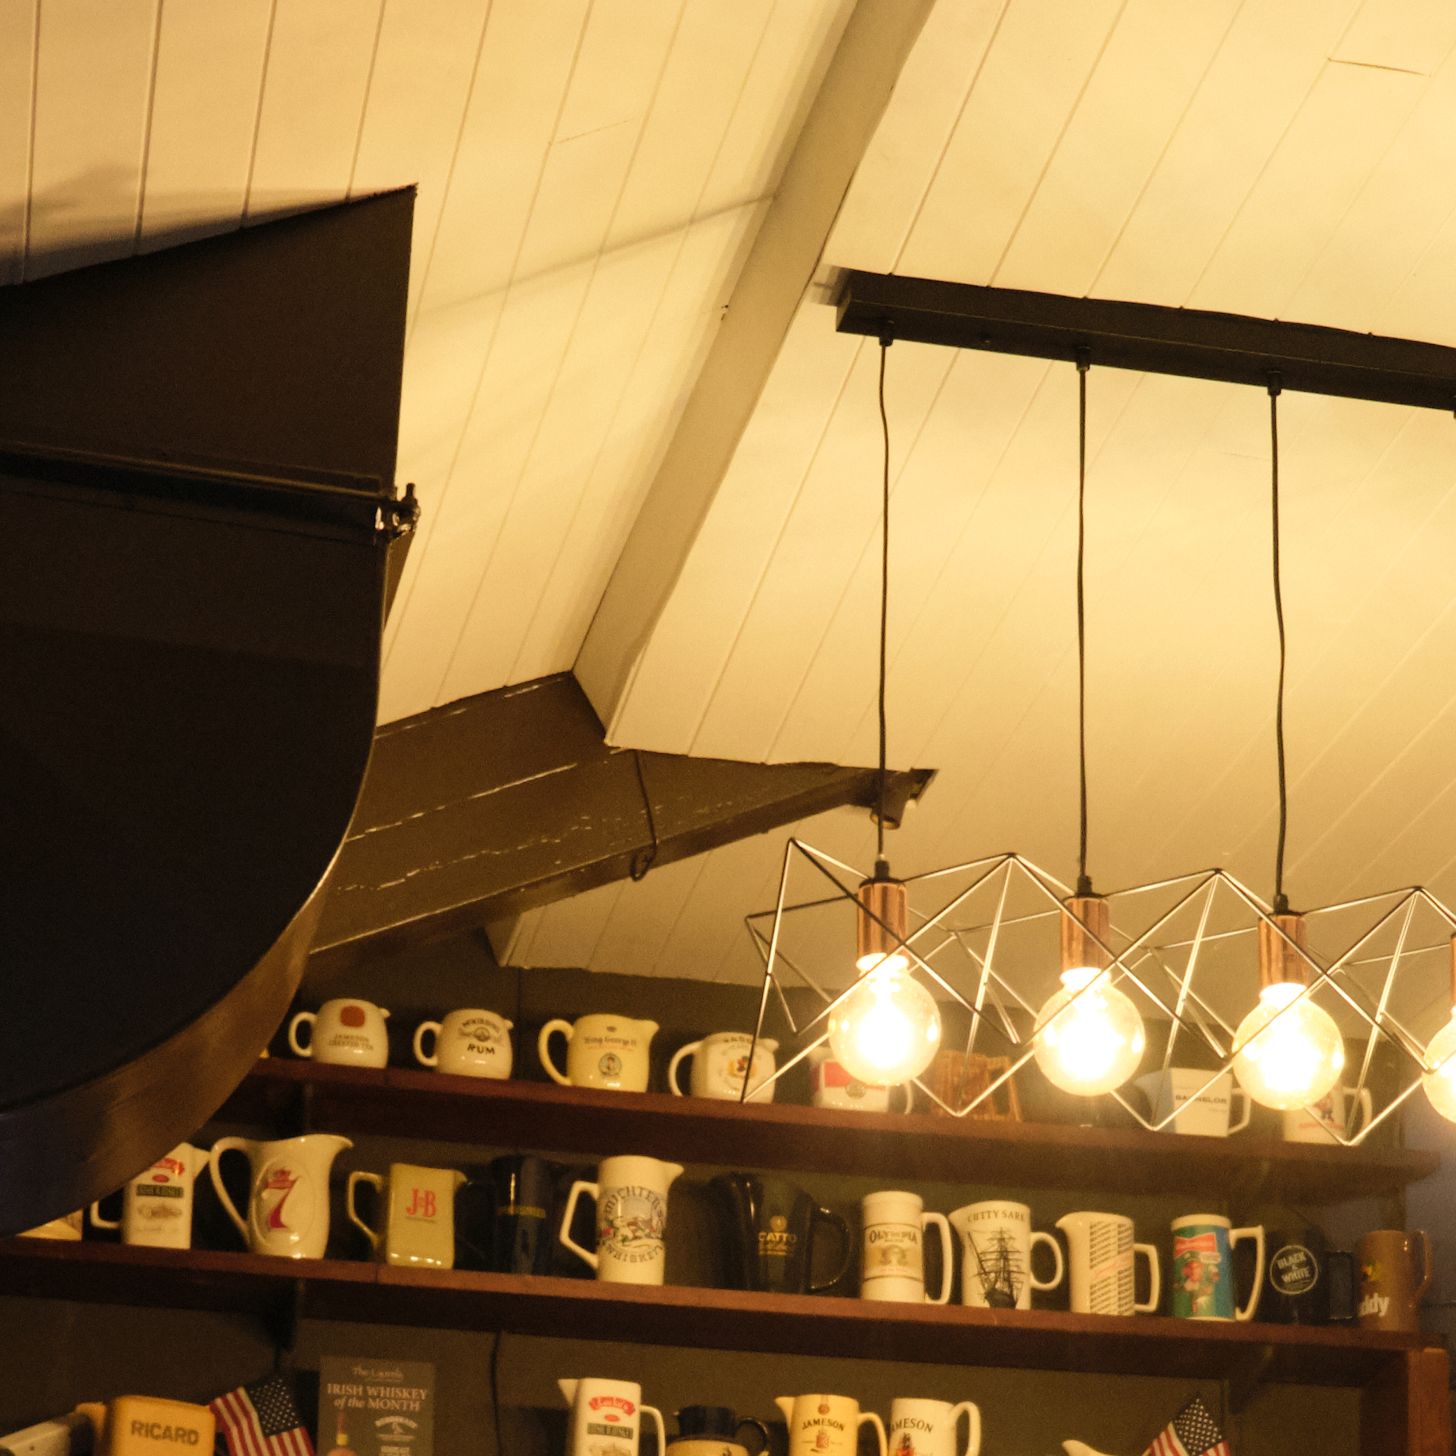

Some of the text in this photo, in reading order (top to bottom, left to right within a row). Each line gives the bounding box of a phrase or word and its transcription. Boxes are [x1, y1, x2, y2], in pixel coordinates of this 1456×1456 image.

[467, 1043, 495, 1055] RUM
[1276, 1251, 1307, 1271] BLACK
[1280, 1268, 1311, 1284] WHITE
[327, 1383, 428, 1400] IRISH WHISKEY
[334, 1397, 421, 1412] of the MONTH
[131, 1420, 199, 1446] RICARD
[802, 1418, 845, 1432] JAMESON
[890, 1417, 934, 1433] AMESON
